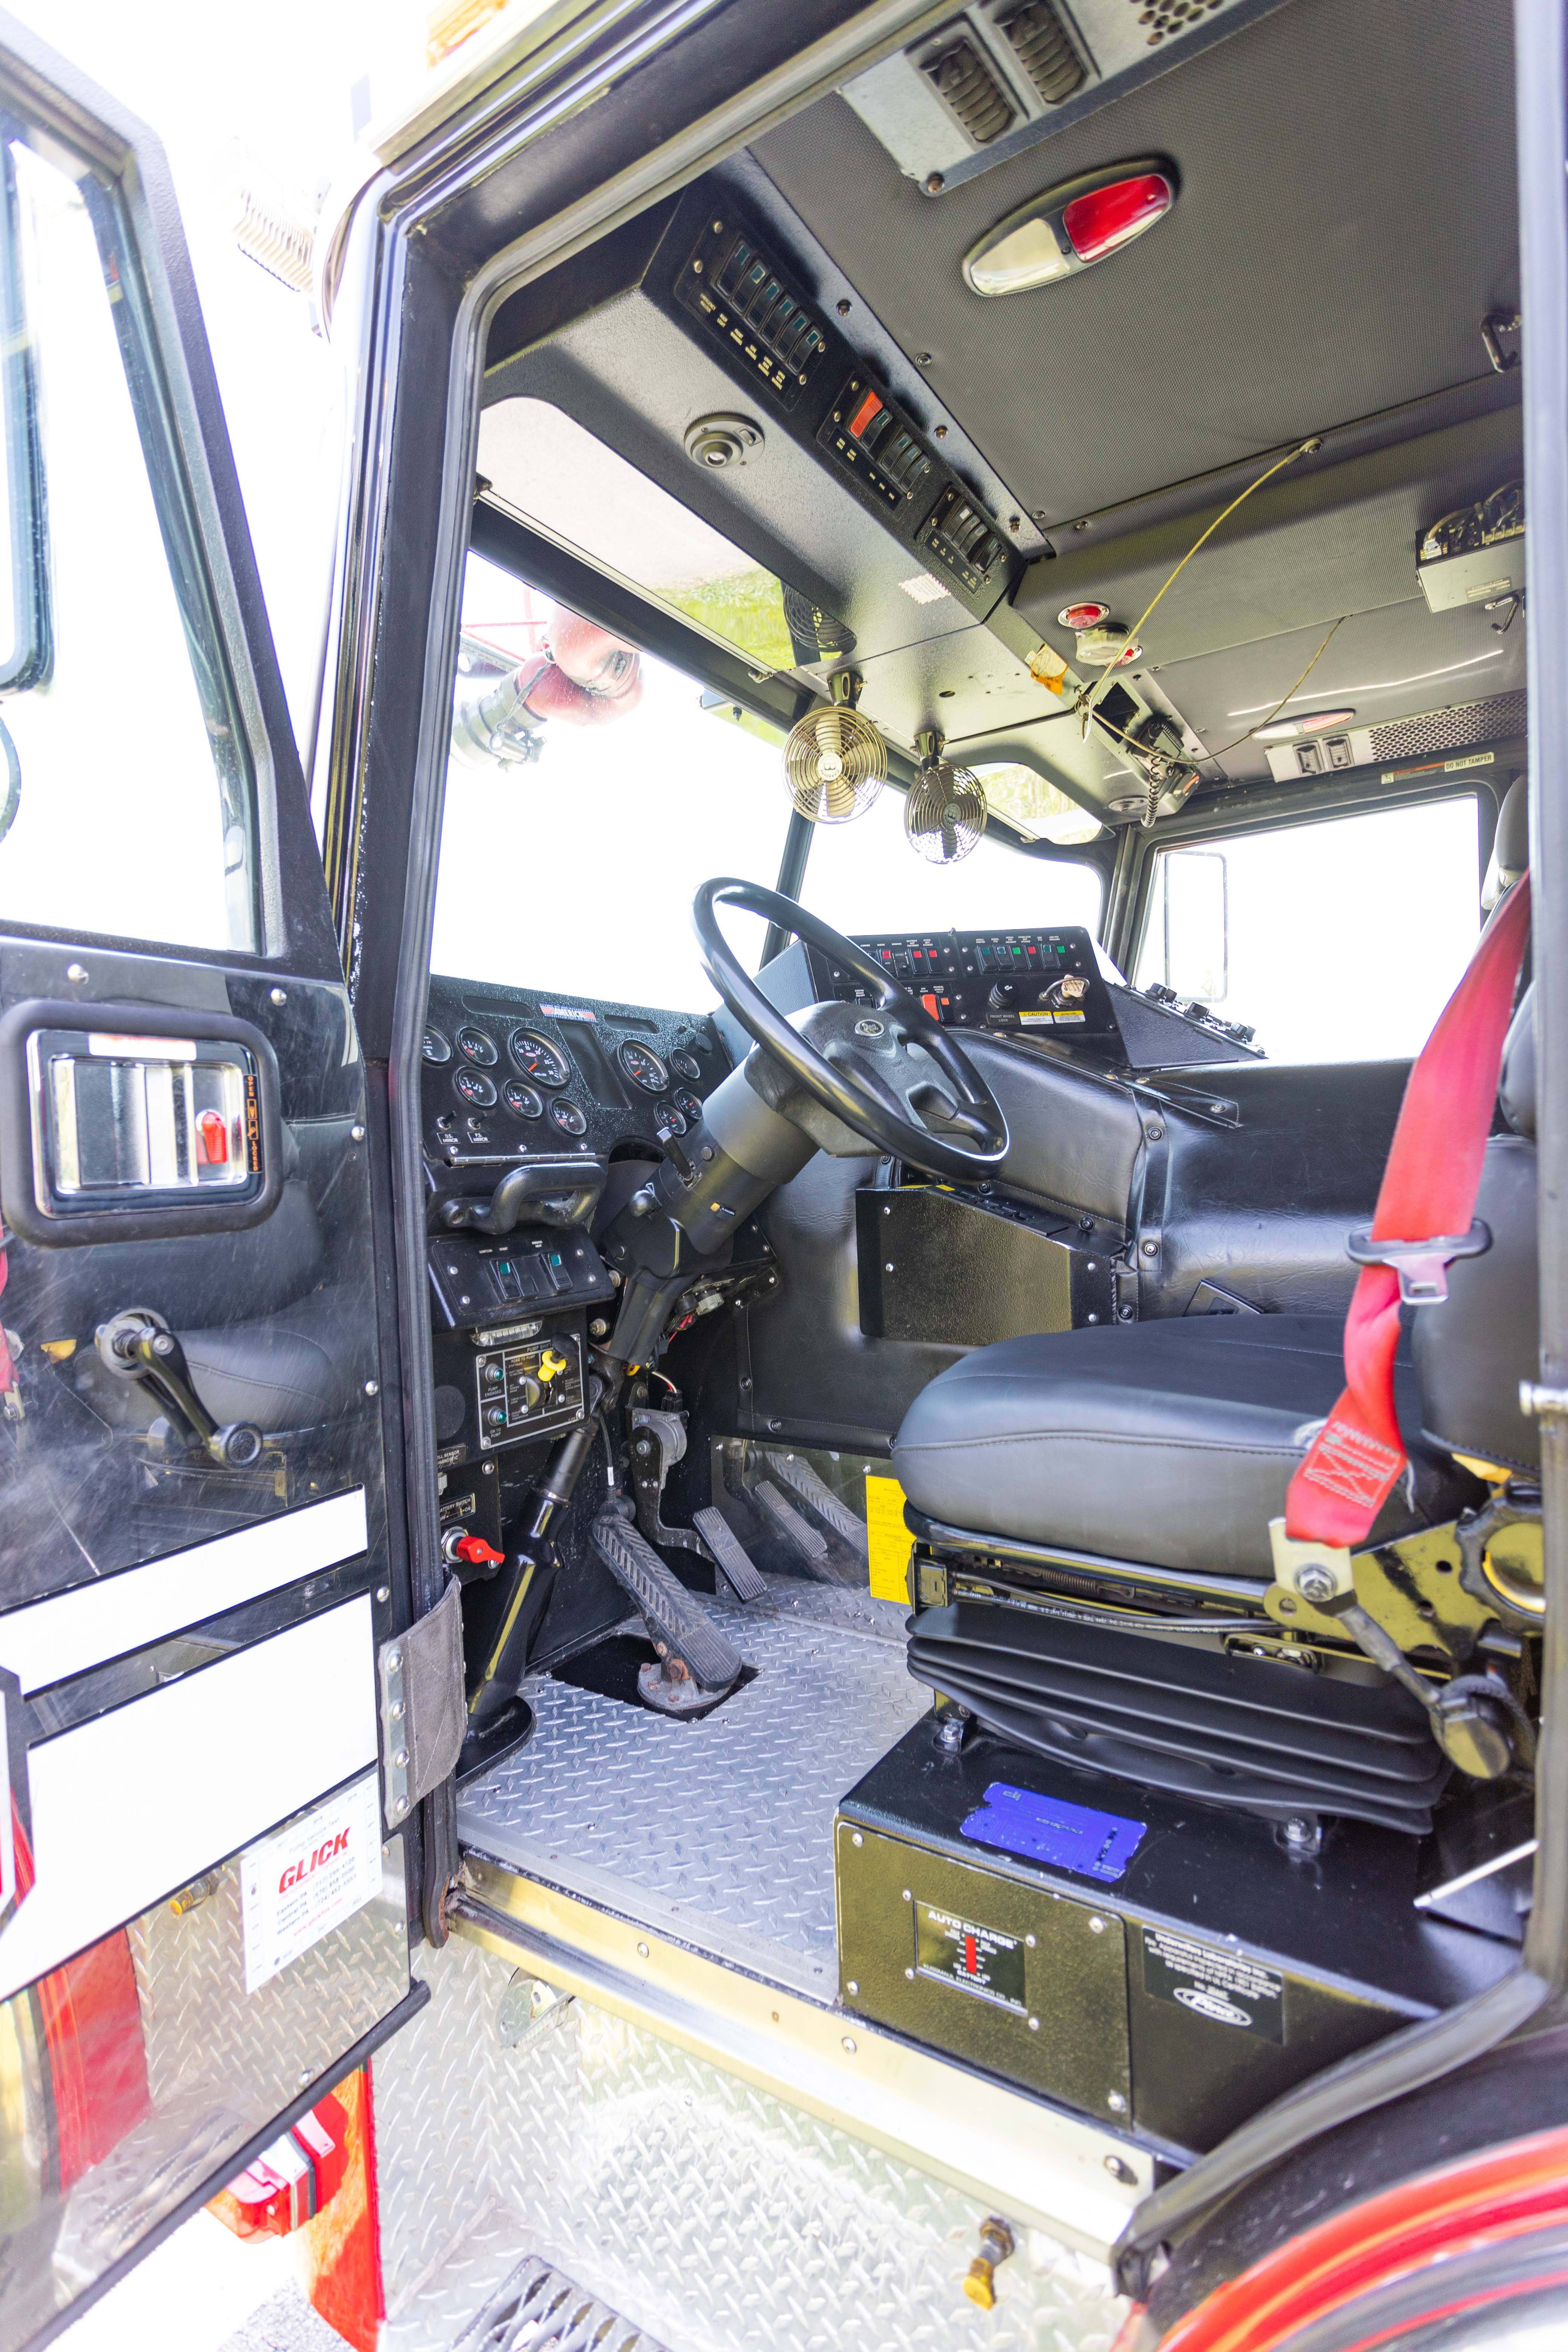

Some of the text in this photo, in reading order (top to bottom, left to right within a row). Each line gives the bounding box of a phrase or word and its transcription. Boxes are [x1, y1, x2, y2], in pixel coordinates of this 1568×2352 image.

[1469, 755, 1491, 764] TAMPER
[554, 1008, 585, 1019] AMERICA
[438, 1455, 458, 1465] IAGNOSTIC
[440, 1498, 470, 1513] ATTERY SWITCH
[278, 1825, 352, 1896] GLICK
[277, 1896, 299, 1917] Eastern
[300, 1890, 307, 1900] PA
[329, 1855, 355, 1879] 299-4120
[277, 1906, 299, 1926] Central
[300, 1899, 308, 1910] PA
[277, 1914, 300, 1937] Western
[302, 1908, 309, 1918] PA
[293, 1895, 343, 1939] www.glickfire.com
[928, 1910, 1015, 1949] AUTO CHARGE
[956, 1976, 995, 1995] ELECTRONICS
[957, 1969, 986, 1985] BATTERY
